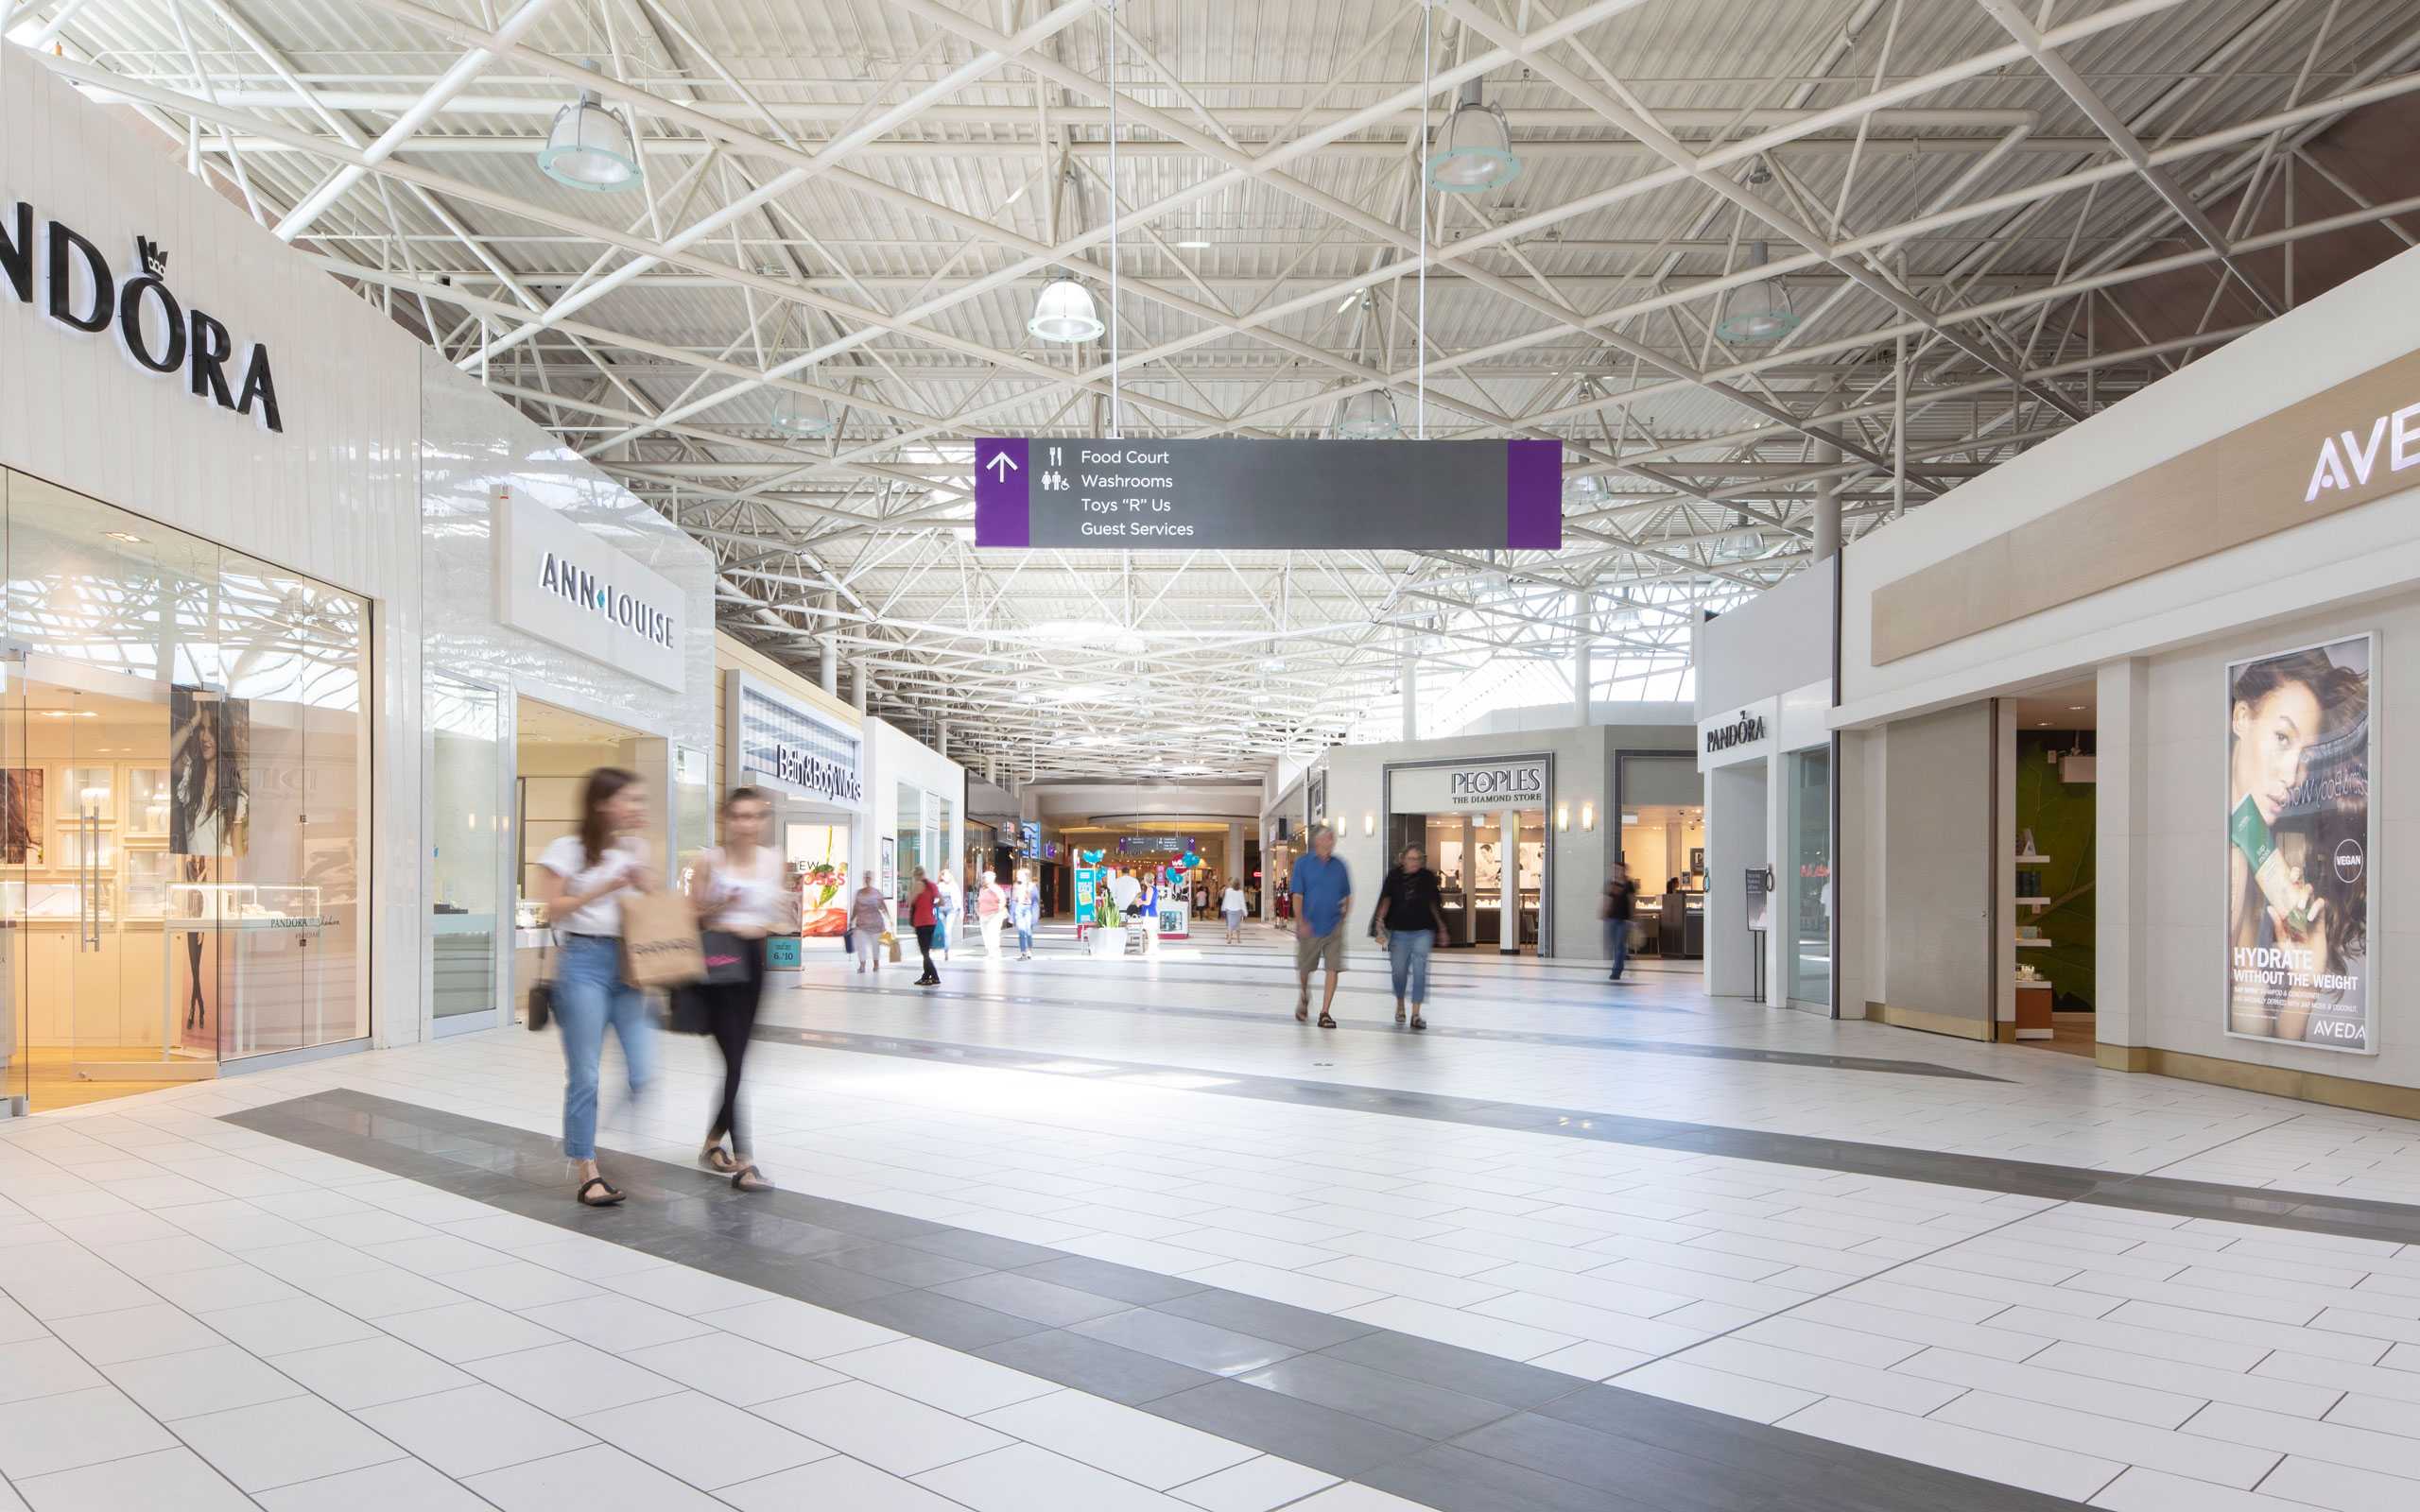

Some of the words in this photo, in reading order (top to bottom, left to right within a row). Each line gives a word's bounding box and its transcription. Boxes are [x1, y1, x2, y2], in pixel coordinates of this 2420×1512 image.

[1081, 450, 1121, 464] Food
[1126, 450, 1169, 464] Court
[2305, 401, 2420, 503] AVE
[1081, 473, 1173, 489] Washrooms
[1081, 498, 1118, 513] Toys
[1151, 498, 1171, 512] Us
[1081, 522, 1126, 536] Guest
[1130, 522, 1194, 536] Services
[540, 552, 595, 610] ANN
[606, 584, 674, 649] LOUISE
[1707, 715, 1765, 753] PANDORA
[1452, 768, 1541, 795] PEOPLES
[1471, 795, 1512, 803] DIAMOND
[1512, 793, 1542, 801] STORE
[2336, 854, 2361, 867] VEGAN
[270, 918, 308, 928] PANDORA
[2234, 947, 2313, 971] HYDRATE
[2234, 969, 2284, 985] WITHOUT
[2287, 971, 2309, 987] THE
[2313, 974, 2359, 990] WEIGHT
[2314, 1020, 2366, 1040] AVEDA
